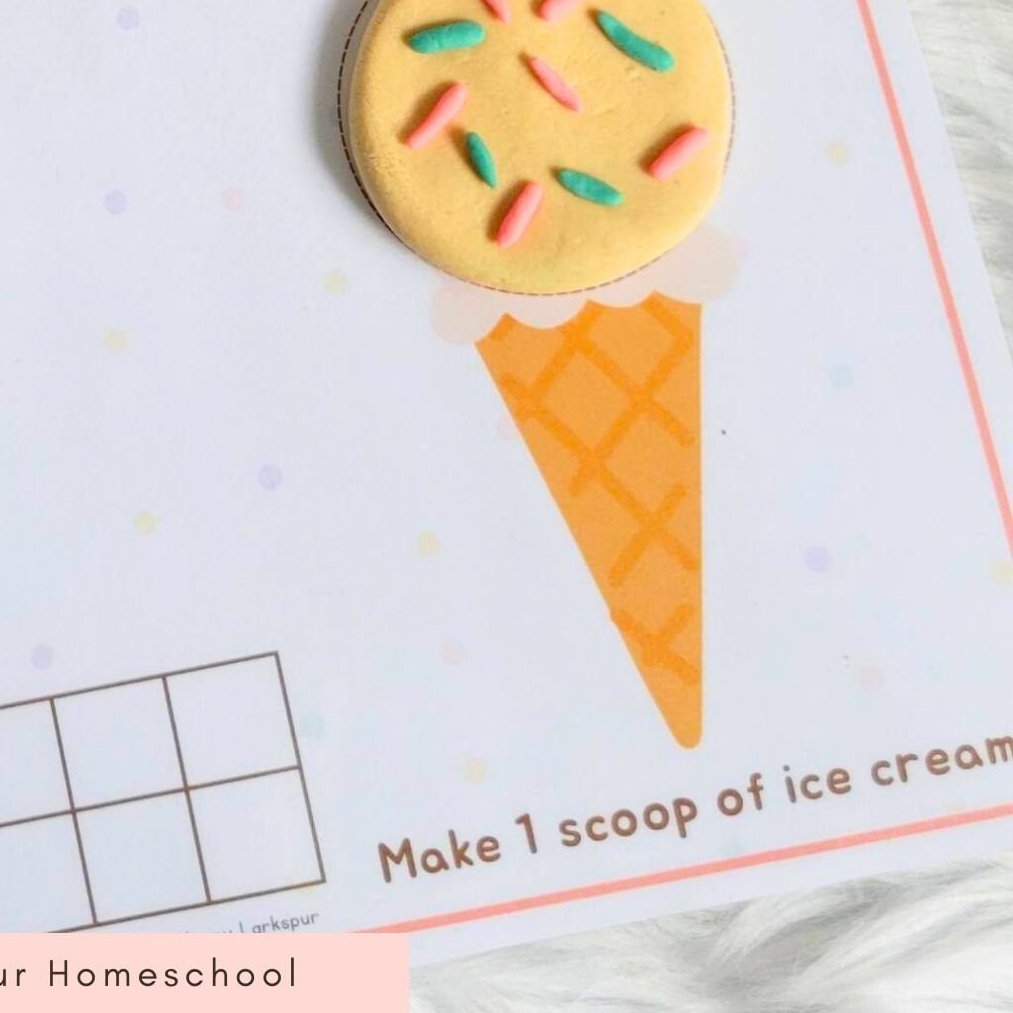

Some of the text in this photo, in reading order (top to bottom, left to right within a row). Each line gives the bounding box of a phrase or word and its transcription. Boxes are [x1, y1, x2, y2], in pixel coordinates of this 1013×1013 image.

[377, 735, 1013, 884] Make 1 scoop of ice cream
